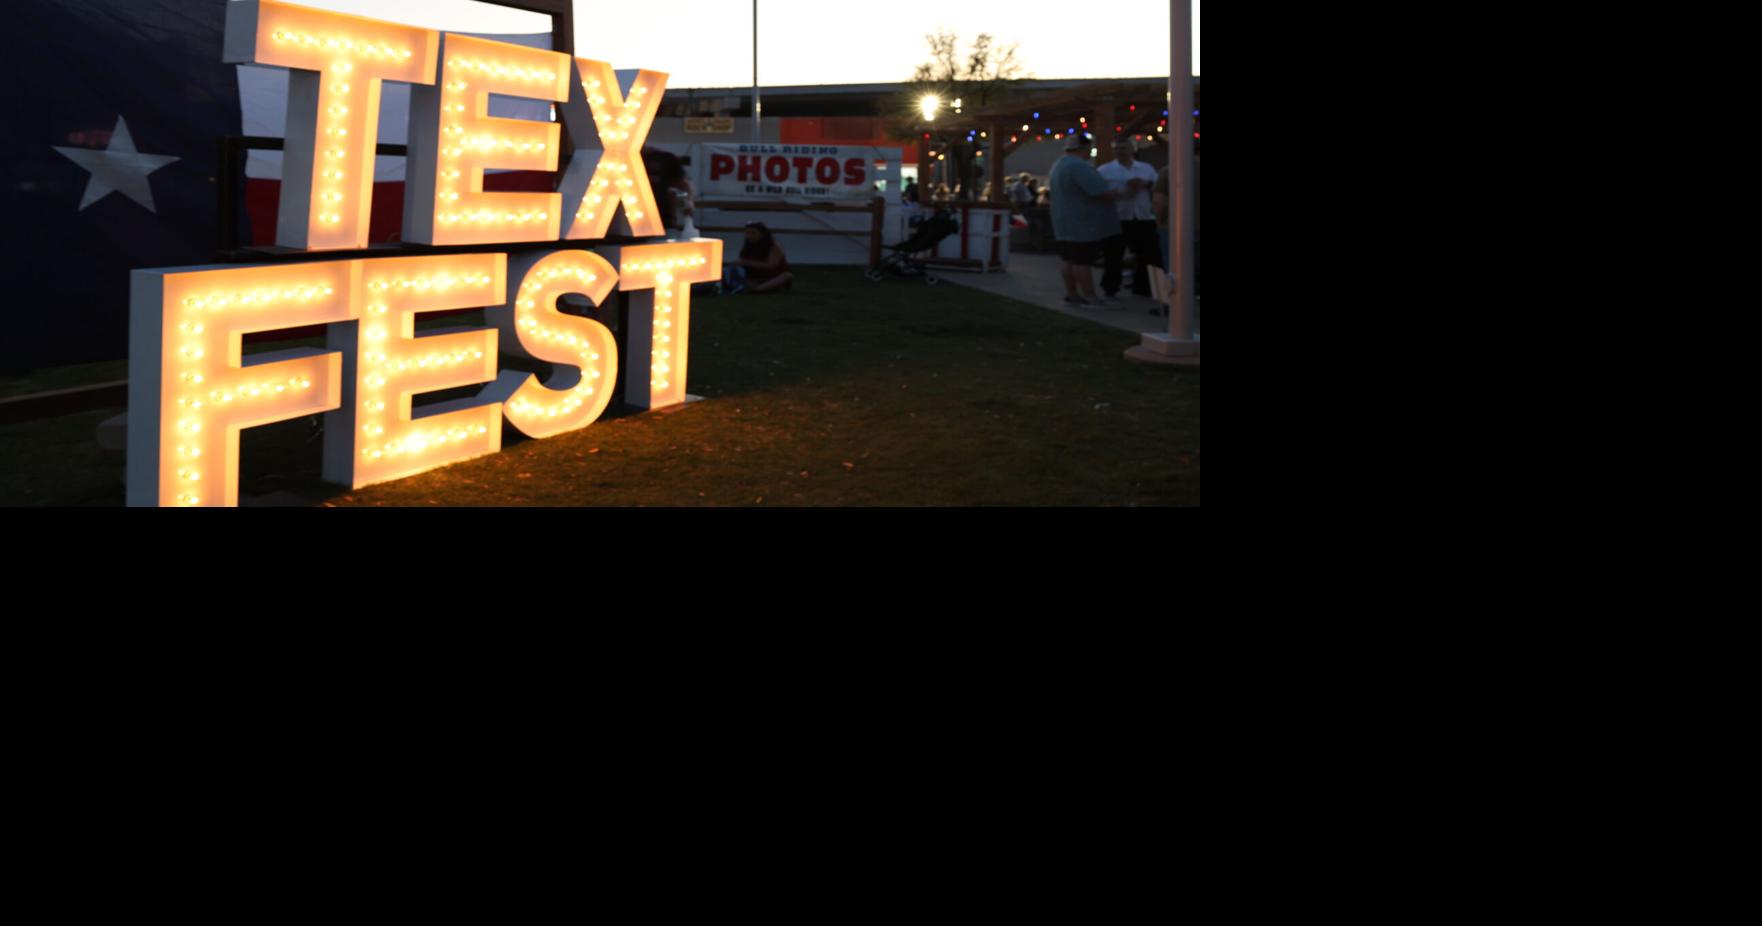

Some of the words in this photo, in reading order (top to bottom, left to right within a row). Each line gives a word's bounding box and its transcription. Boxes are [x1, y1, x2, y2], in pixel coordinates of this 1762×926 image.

[246, 0, 670, 251] TEX
[709, 153, 866, 186] PHOTOS
[739, 145, 778, 153] BULL
[783, 146, 838, 155] RIDING
[146, 239, 724, 507] FEST
